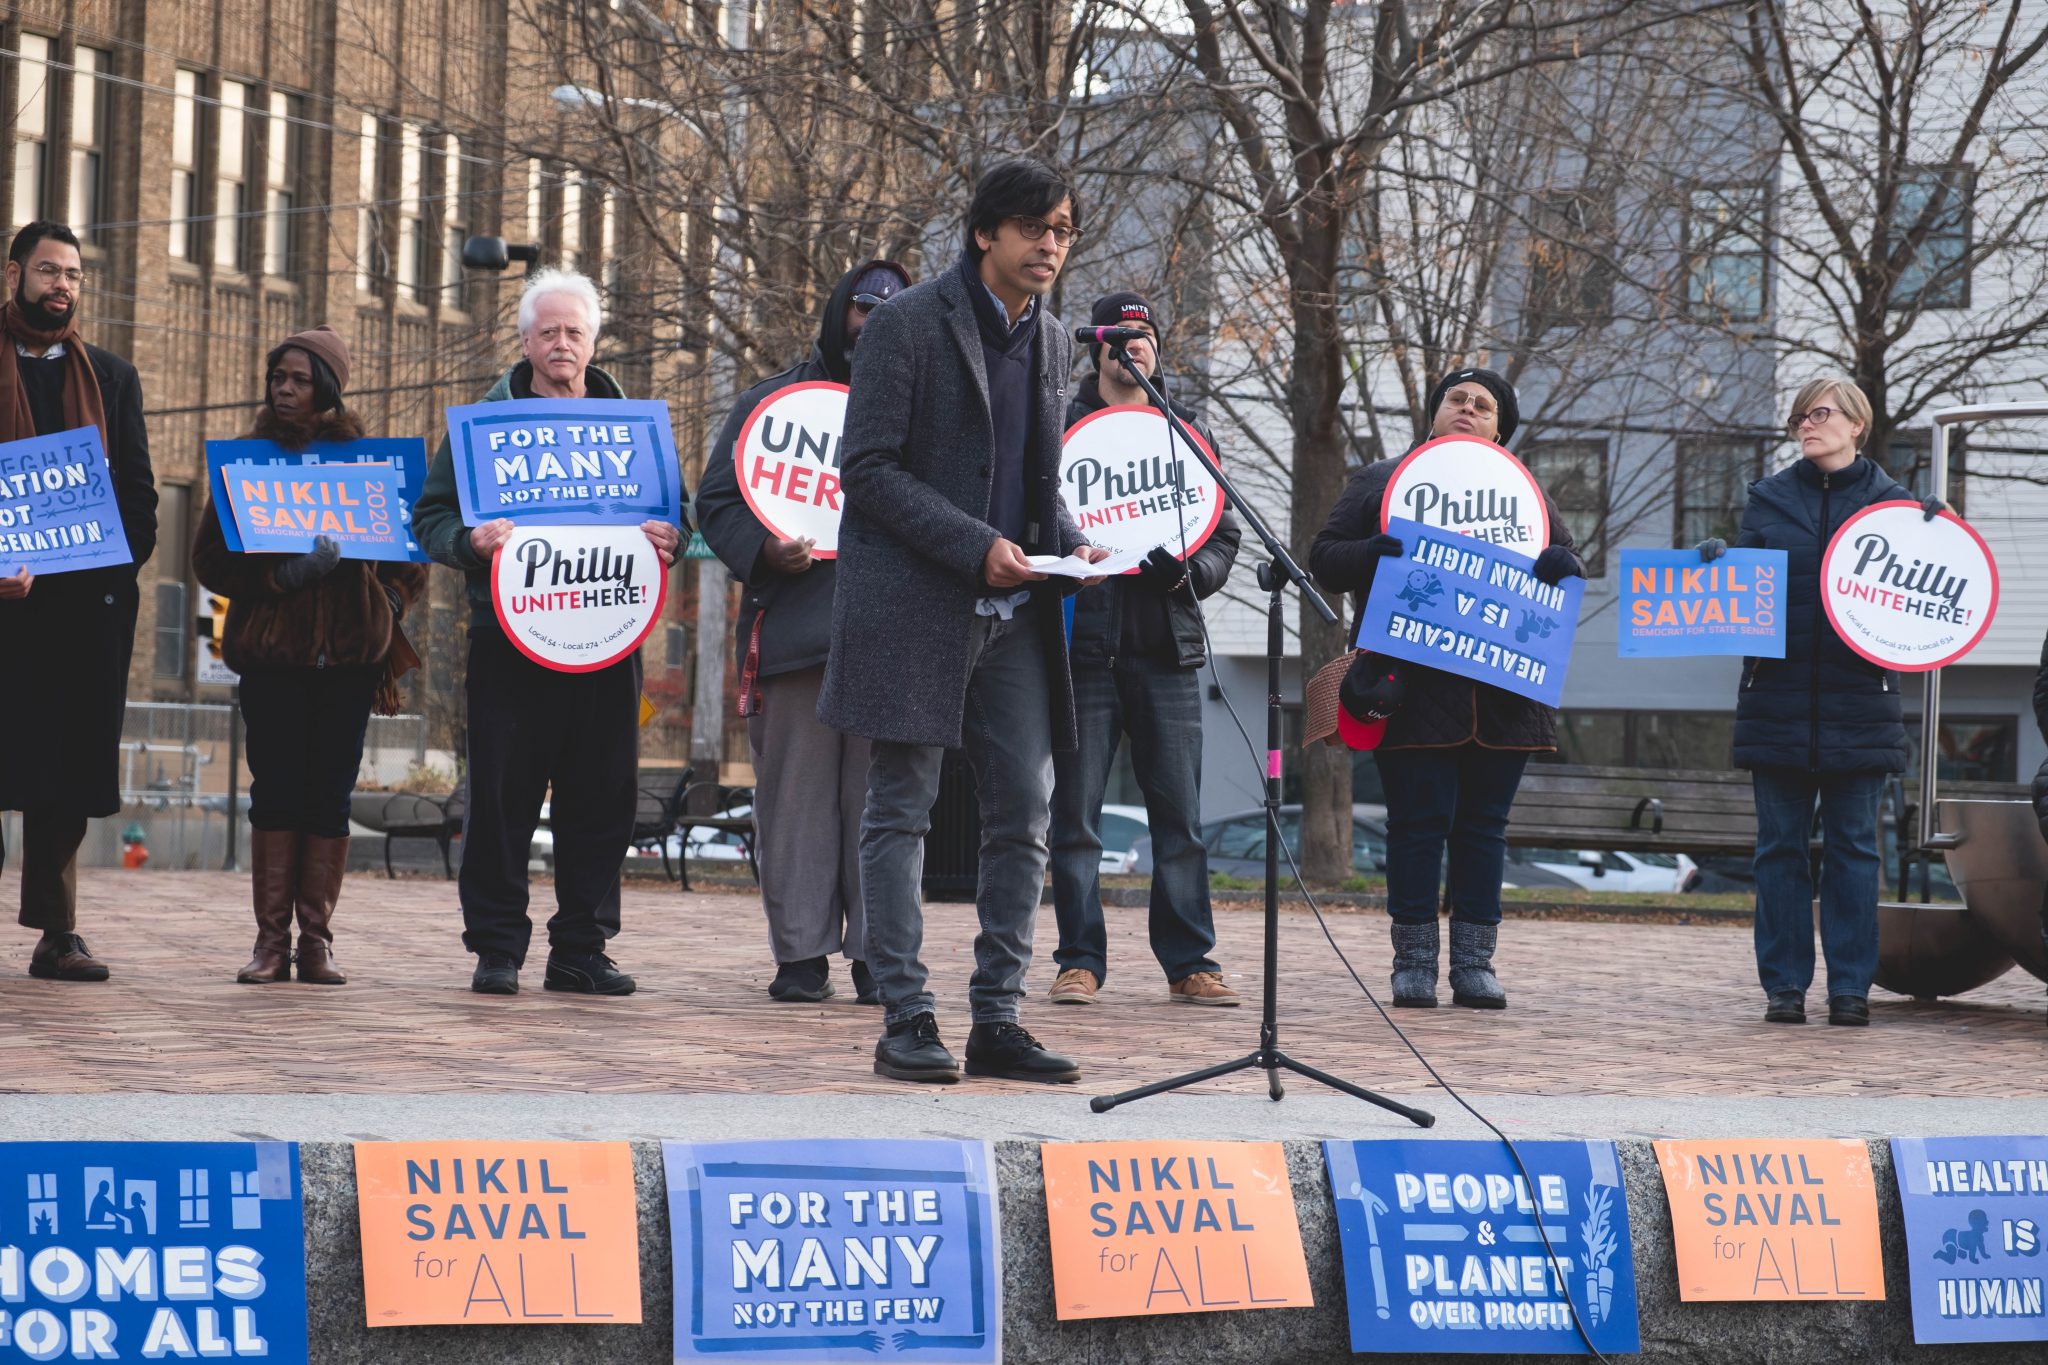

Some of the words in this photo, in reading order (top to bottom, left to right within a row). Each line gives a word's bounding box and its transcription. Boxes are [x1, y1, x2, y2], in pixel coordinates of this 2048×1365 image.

[1121, 304, 1149, 313] UNITE
[489, 427, 558, 451] FOR
[566, 425, 632, 445] THE
[494, 450, 635, 485] MANY
[1066, 456, 1185, 506] Philly
[241, 480, 360, 506] NIKIL
[365, 481, 391, 535] 2020
[499, 488, 543, 504] NOT
[549, 486, 590, 499] THE
[595, 484, 640, 497] FEW
[1404, 482, 1517, 527] Philly
[249, 506, 368, 533] SAVAL
[254, 527, 304, 538] DEMOCRAT
[360, 535, 395, 543] SENATE
[1171, 526, 1190, 541] Loal
[1188, 516, 1199, 527] 634
[516, 538, 634, 589] Philly
[1411, 539, 1485, 580] RIGHT
[1853, 533, 1968, 609] Philly
[1489, 561, 1566, 612] HUMAN
[1632, 566, 1748, 594] NIKIL
[1755, 565, 1775, 626] 2020
[1457, 593, 1476, 616] A
[1482, 603, 1510, 629] IS
[1631, 598, 1750, 626] SAVAL
[528, 626, 547, 643] Local
[547, 639, 556, 647] 54
[563, 642, 583, 650] Local
[604, 628, 624, 643] Local
[623, 617, 636, 630] 634
[1632, 628, 1683, 637] DEMOCRAT
[1687, 627, 1705, 635] FOR
[1708, 625, 1737, 634] STATE
[1740, 626, 1776, 636] SENATE
[1846, 609, 1862, 628] Local
[1861, 627, 1871, 637] 54
[1875, 635, 1896, 648] Local
[1897, 643, 1911, 651] 274
[1918, 641, 1939, 650] Local
[1940, 635, 1954, 645] 634
[1389, 615, 1547, 685] HEALTHCARE
[406, 1158, 568, 1194] NIKIL
[1088, 1157, 1234, 1193] NIKIL
[1696, 1154, 1824, 1185] NIKIL
[728, 1191, 829, 1226] FOR
[844, 1190, 940, 1223] THE
[1395, 1173, 1567, 1212] PEOPLE
[1706, 1193, 1840, 1226] SAVAL
[406, 1203, 586, 1241] SAVAL
[1090, 1198, 1254, 1238] SAVAL
[1477, 1220, 1496, 1245] &
[2002, 1219, 2037, 1252] IS
[731, 1236, 940, 1289] MANY
[1099, 1246, 1139, 1273] for
[1146, 1244, 1287, 1309] ALL
[1405, 1255, 1571, 1293] PLANET
[1713, 1235, 1745, 1260] for
[1753, 1237, 1866, 1296] ALL
[414, 1251, 457, 1278] for
[464, 1253, 614, 1317] ALL
[1938, 1278, 2043, 1316] HUMAN
[733, 1302, 796, 1325] NOT
[805, 1300, 866, 1323] THE
[874, 1298, 941, 1321] FEW
[1409, 1301, 1479, 1326] OVER
[1484, 1302, 1574, 1327] PROFIT
[141, 1307, 266, 1355] ALL
